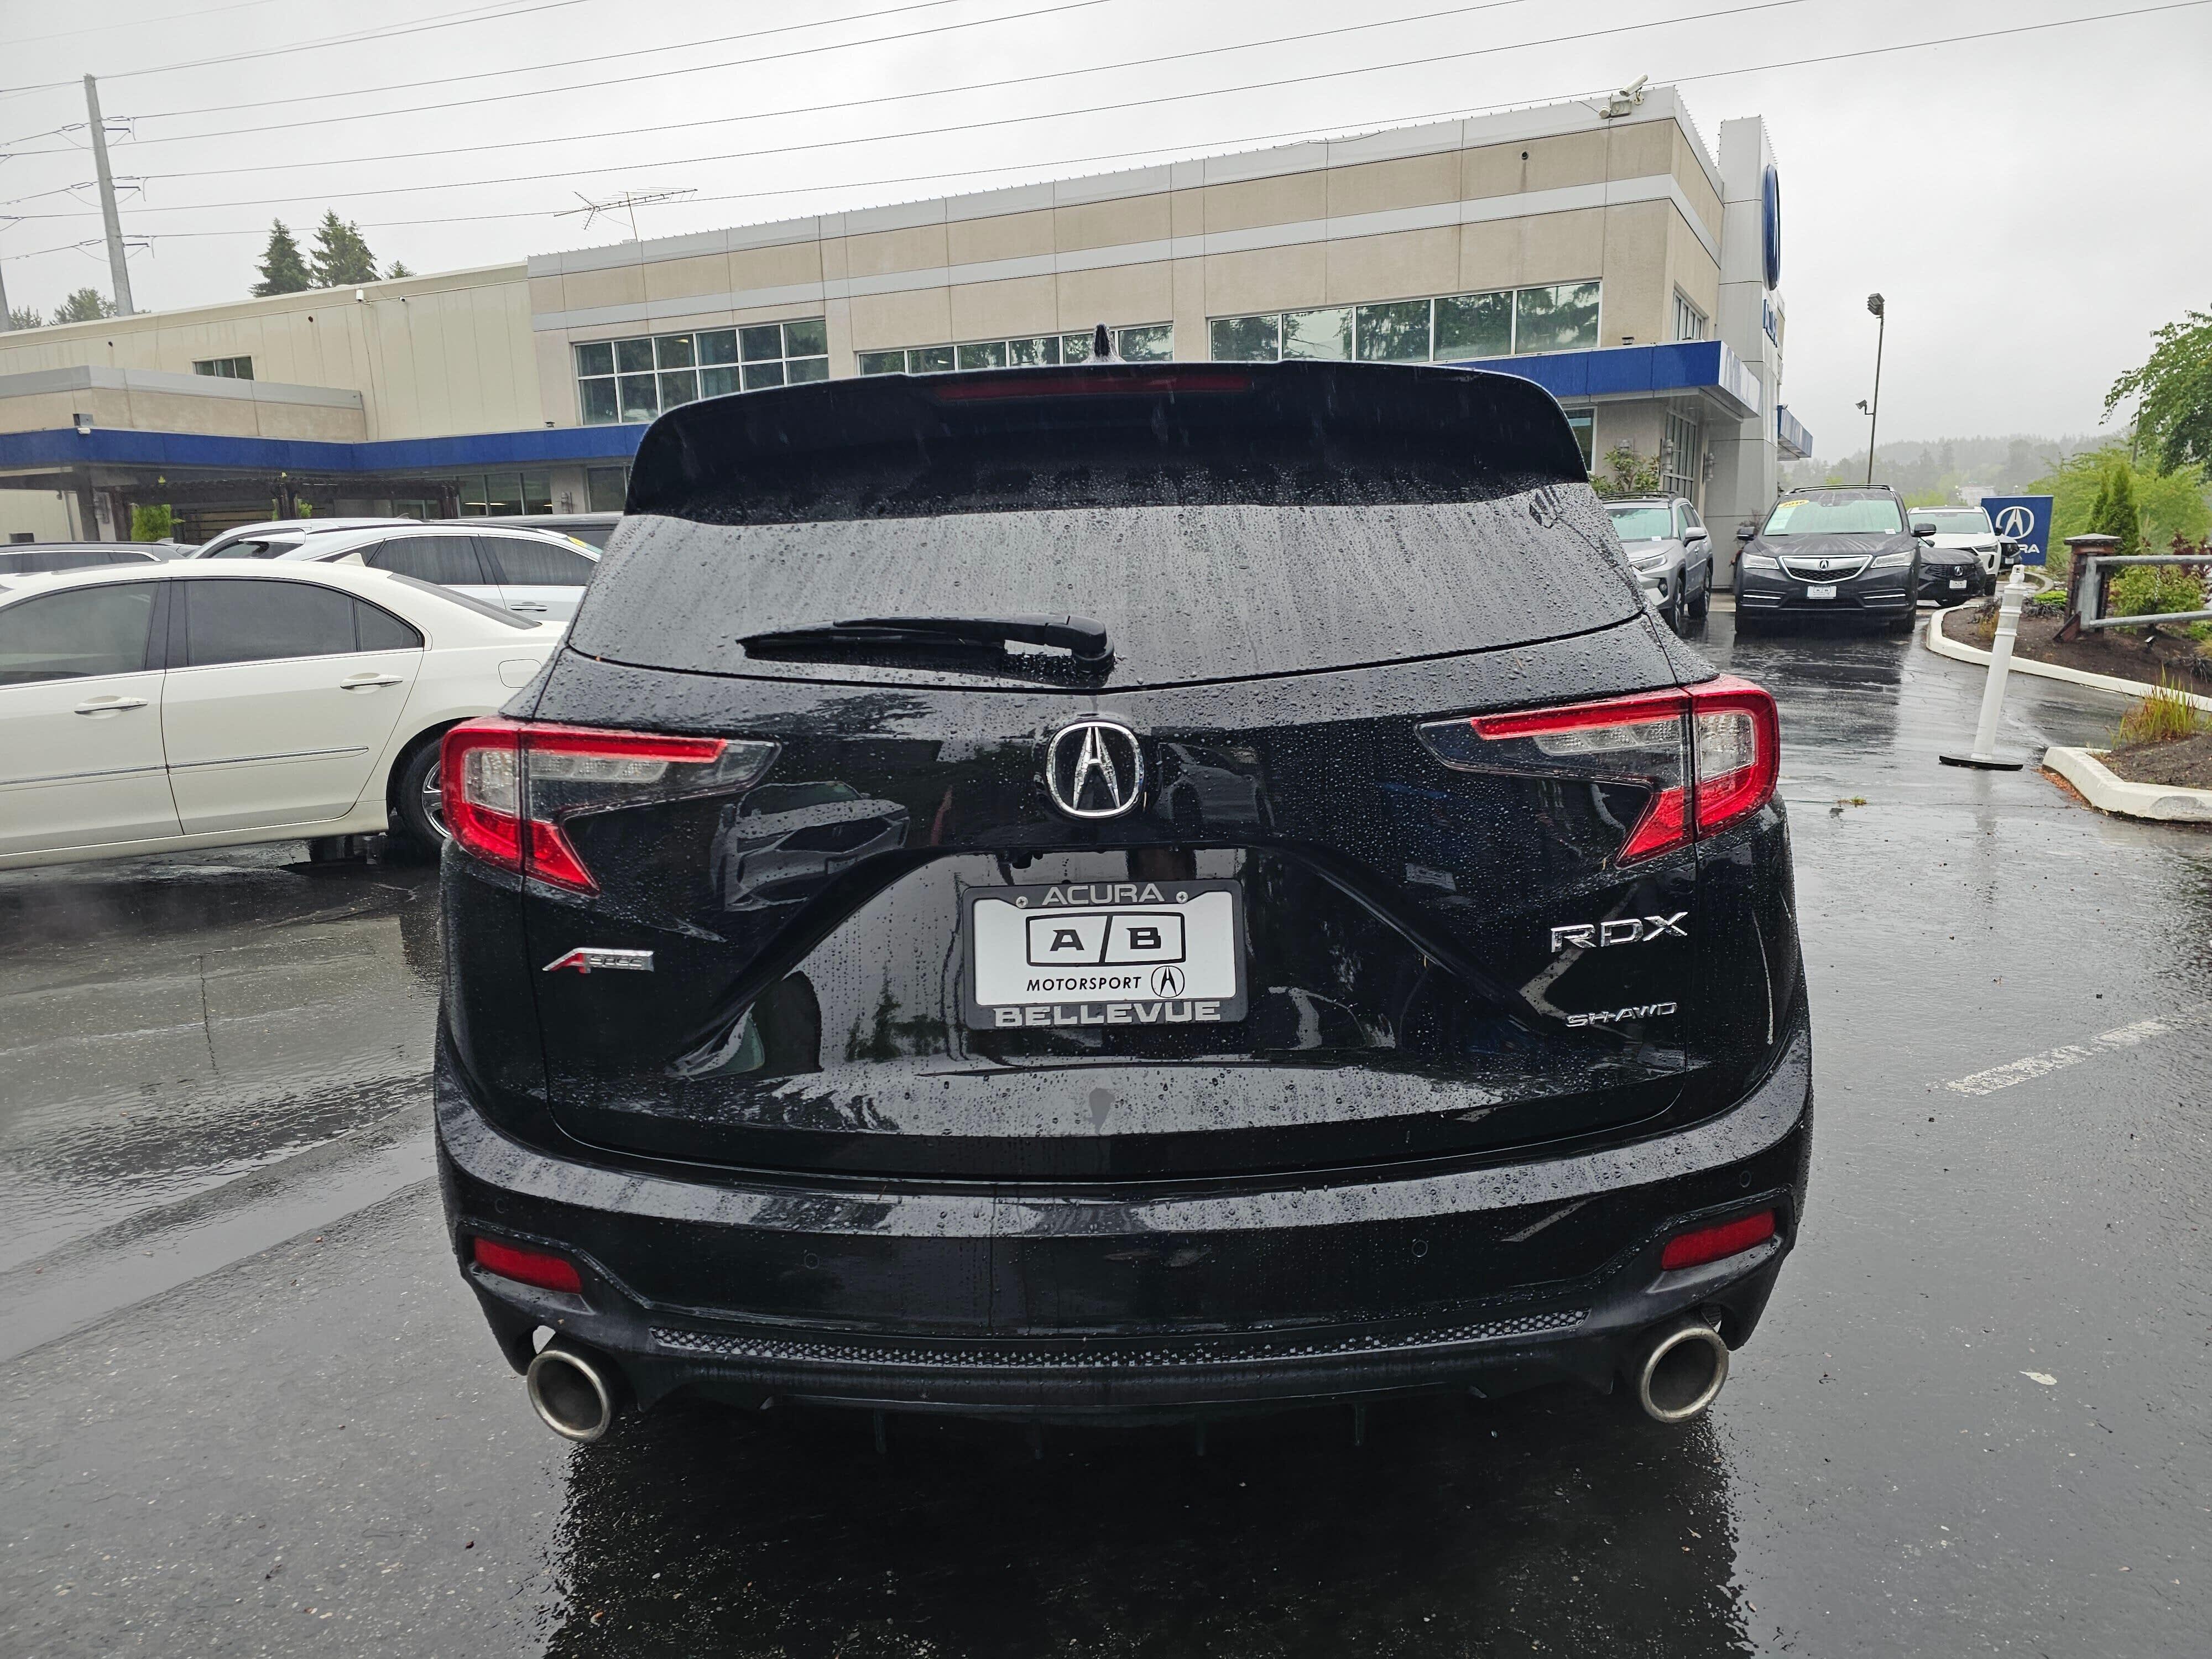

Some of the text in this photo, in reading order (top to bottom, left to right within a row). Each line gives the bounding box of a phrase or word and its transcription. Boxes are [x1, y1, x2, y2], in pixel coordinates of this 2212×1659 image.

[1042, 883, 1165, 906] ACURA
[1049, 927, 1161, 952] A B
[1551, 911, 1688, 953] RDX
[1026, 976, 1142, 992] MOTORSPORT
[993, 1001, 1220, 1027] BELLEVUE
